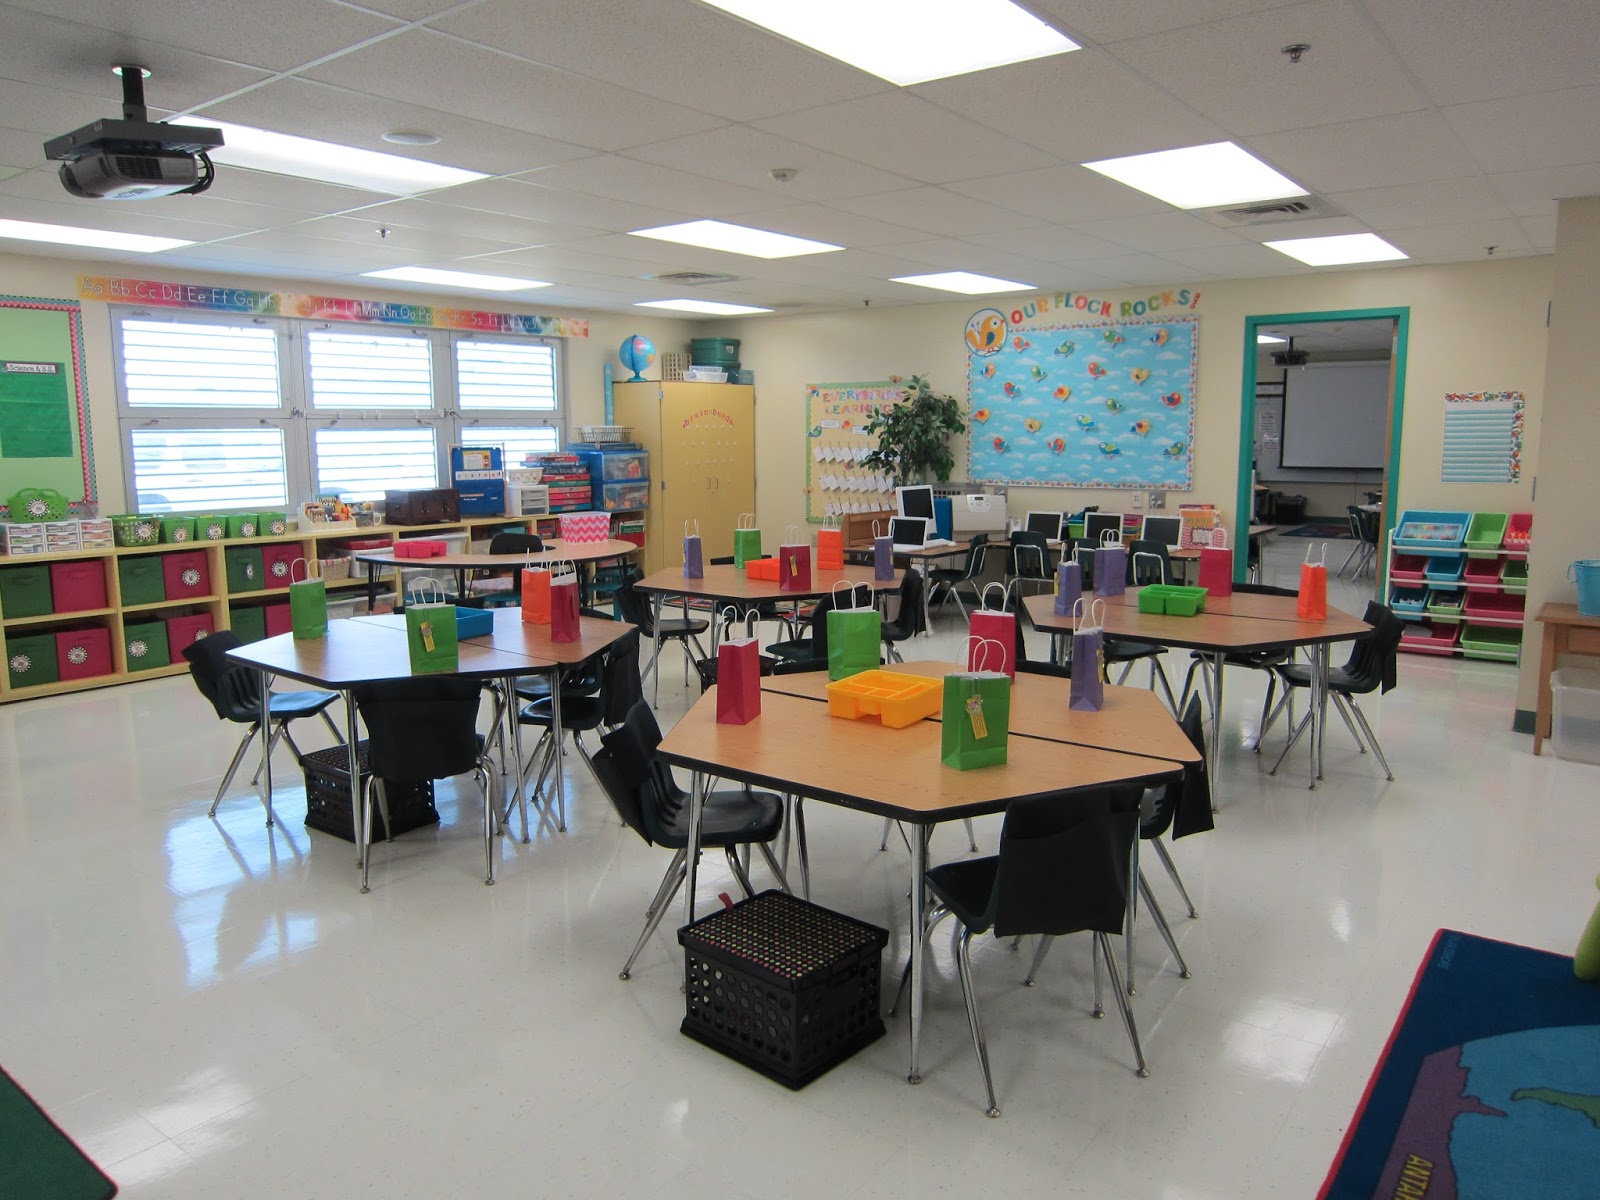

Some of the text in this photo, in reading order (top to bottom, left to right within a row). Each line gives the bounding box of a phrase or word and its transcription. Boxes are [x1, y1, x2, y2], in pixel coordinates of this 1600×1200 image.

[82, 277, 103, 294] Aa
[109, 279, 130, 296] Bb
[135, 282, 156, 299] Cc
[161, 284, 182, 301] Dd
[187, 287, 206, 303] Ee
[212, 289, 229, 305] Ff
[233, 291, 254, 311] Gg
[322, 299, 338, 313] Kk
[361, 302, 380, 317] Mm
[383, 304, 398, 318] Nn
[400, 305, 415, 320] Oo
[419, 307, 432, 324] Pp
[471, 312, 483, 325] Ss
[1010, 296, 1049, 325] OUR
[1054, 292, 1112, 318] FLOCK
[9, 364, 35, 372] Science
